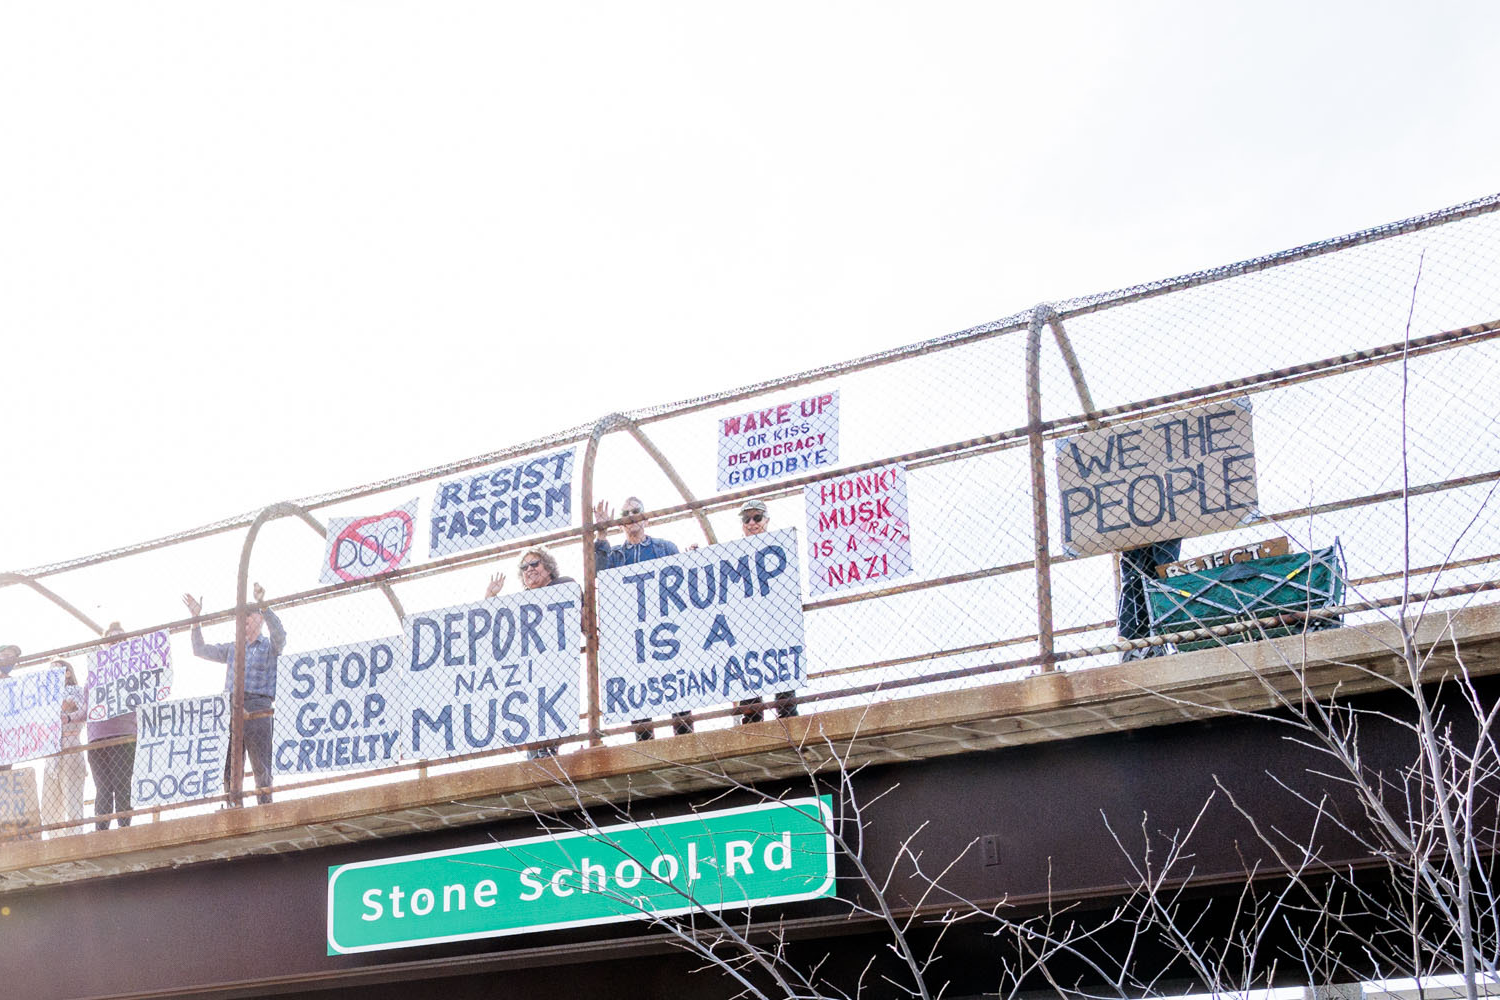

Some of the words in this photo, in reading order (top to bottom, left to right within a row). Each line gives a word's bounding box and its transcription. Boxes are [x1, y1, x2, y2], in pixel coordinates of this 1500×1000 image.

[724, 403, 792, 438] WAKE
[801, 394, 834, 418] UP
[747, 433, 767, 447] OR
[773, 422, 810, 442] KISS
[728, 432, 827, 467] DEMOCRACY
[1070, 429, 1148, 479] WE
[1153, 410, 1241, 463] THE
[439, 451, 572, 511] RESIST
[728, 449, 828, 486] GOODBYE
[820, 468, 898, 506] HONK!
[431, 482, 572, 550] FASCISM
[818, 497, 893, 533] MUSK
[1062, 453, 1259, 543] PEOPLE
[813, 539, 834, 560] IS
[846, 535, 858, 552] A
[623, 544, 787, 623] TRUMP
[827, 553, 889, 588] NAZI
[96, 631, 167, 667] DEFEND
[410, 600, 575, 673] DEPORT
[635, 622, 681, 664] IS
[702, 613, 737, 650] A
[95, 668, 165, 704] DEPORT
[291, 644, 394, 700] STOP
[454, 659, 534, 697] NAZI
[722, 645, 804, 697] ASSET
[107, 687, 158, 719] ELON
[141, 696, 227, 739] NEUTER
[296, 693, 387, 738] G.O.P.
[412, 682, 568, 752] MUSK
[140, 735, 220, 773] THE
[275, 729, 400, 773] CRUELTY
[137, 767, 220, 802] DOGE
[361, 878, 499, 922] Stone
[518, 842, 702, 901] School
[726, 830, 793, 877] Rd
